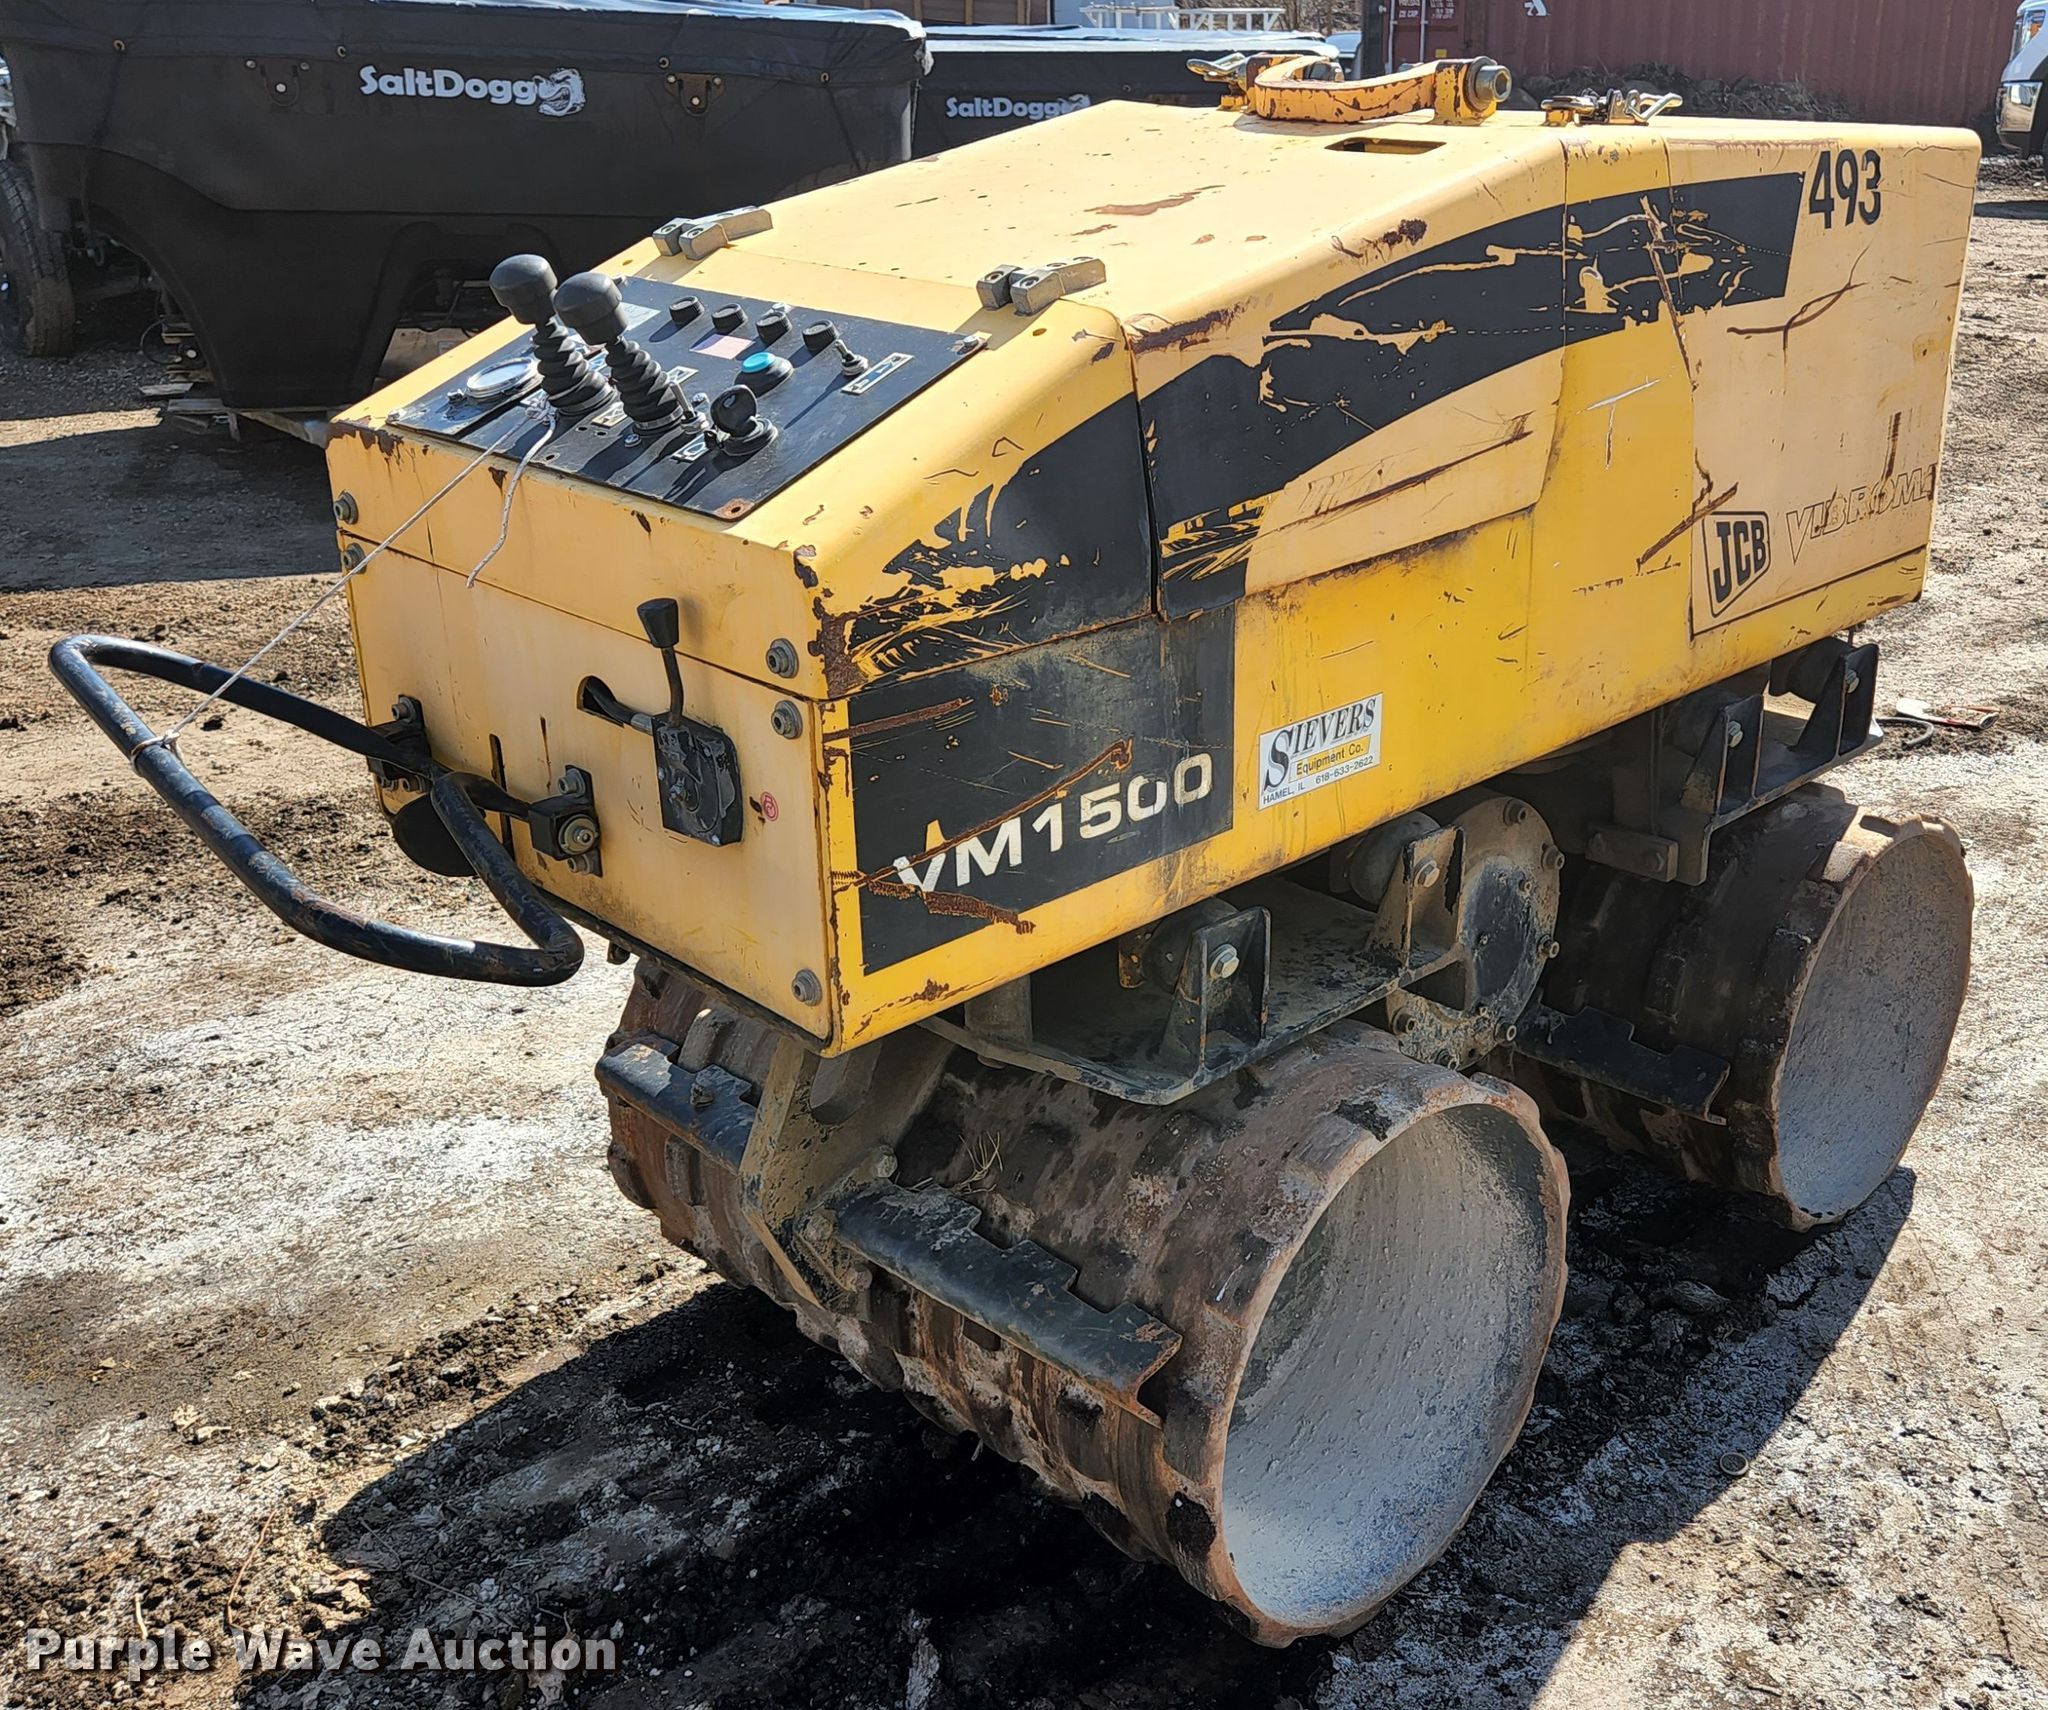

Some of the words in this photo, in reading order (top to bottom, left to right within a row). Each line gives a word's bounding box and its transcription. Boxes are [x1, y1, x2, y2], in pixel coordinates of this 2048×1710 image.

[359, 65, 538, 105] SaltDogg
[945, 96, 1060, 121] SaltDogg
[1808, 149, 1881, 229] 493
[1713, 519, 1766, 603] JCB
[1262, 697, 1377, 792] SIEVERS
[1296, 749, 1345, 776] Equipment
[1348, 743, 1364, 757] Co.
[1297, 782, 1306, 792] IL
[1315, 755, 1374, 785] 618-633-2622
